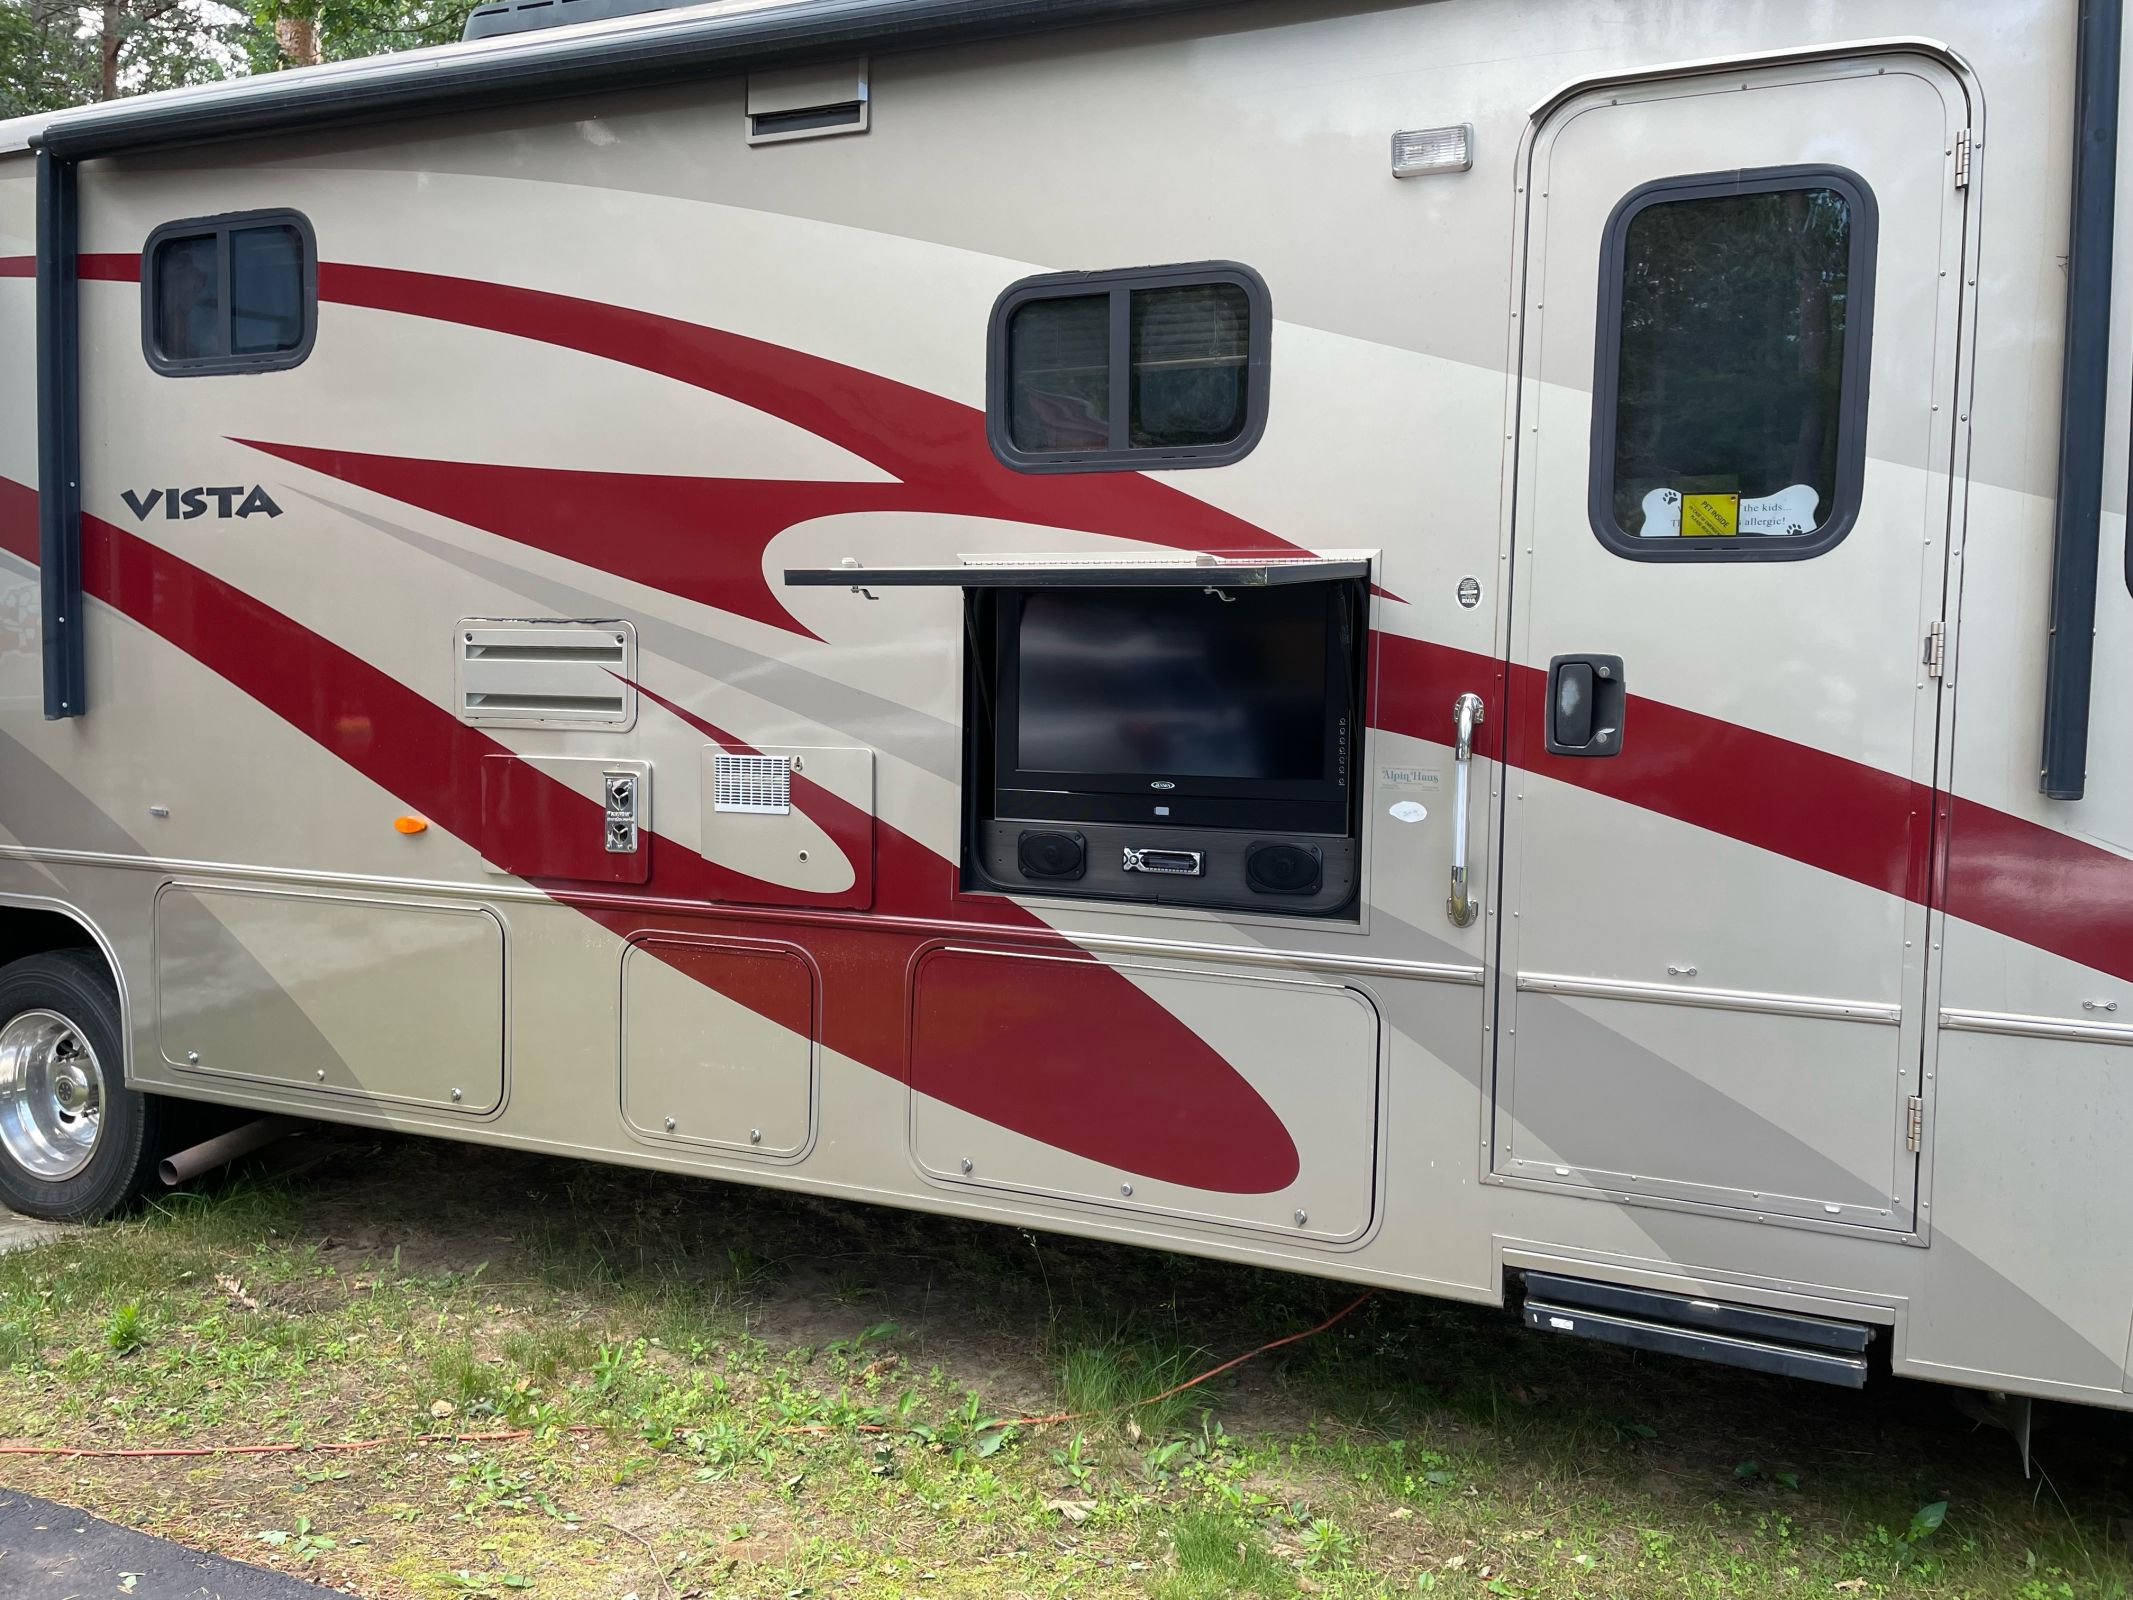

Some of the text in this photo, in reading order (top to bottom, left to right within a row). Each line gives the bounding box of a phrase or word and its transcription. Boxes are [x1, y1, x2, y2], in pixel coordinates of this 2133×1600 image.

[121, 484, 284, 522] VISTA
[1743, 503, 1759, 512] the
[1701, 500, 1729, 529] PET INSIDE
[1744, 517, 1785, 528] allergic!
